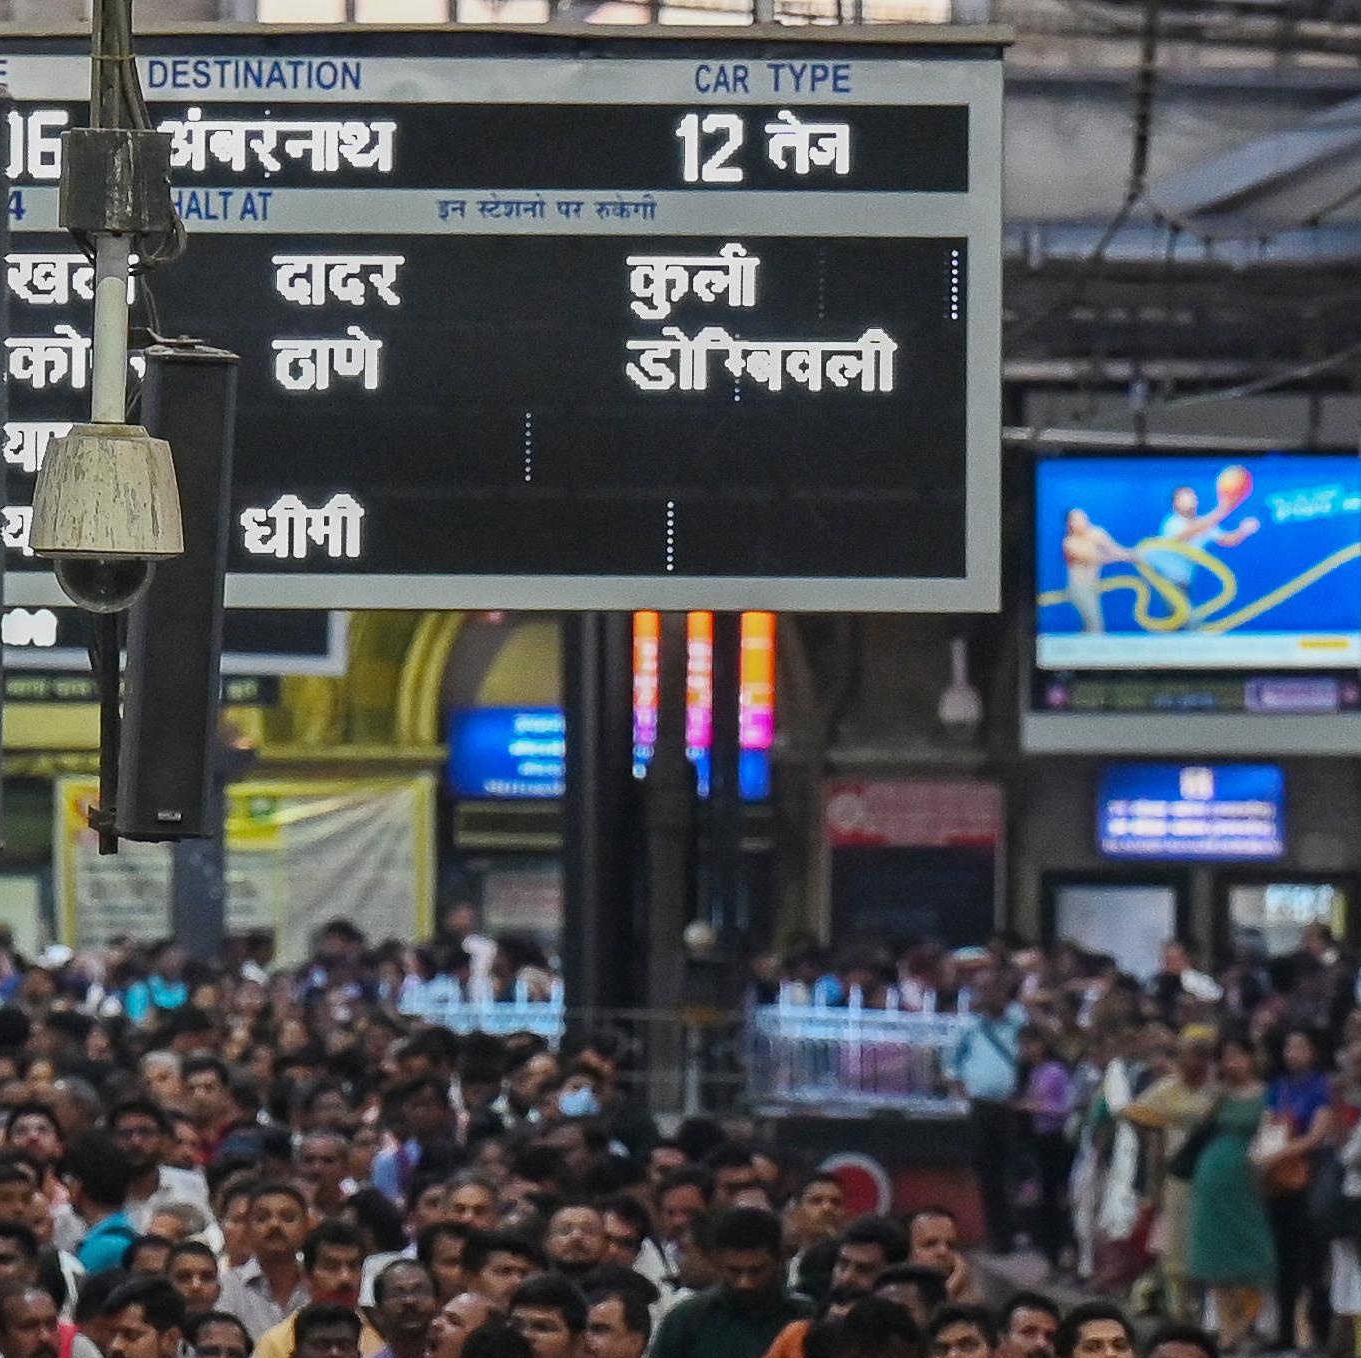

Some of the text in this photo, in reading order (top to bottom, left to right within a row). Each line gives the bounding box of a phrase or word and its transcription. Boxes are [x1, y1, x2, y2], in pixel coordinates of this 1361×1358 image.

[149, 60, 362, 90] DESTINATION
[695, 64, 749, 93] CAR
[767, 63, 850, 93] TYPE
[676, 114, 743, 182] 12
[240, 192, 272, 220] AT
[271, 256, 405, 305] दादर
[271, 326, 382, 390] ठाणे
[241, 494, 365, 558] धीमी
